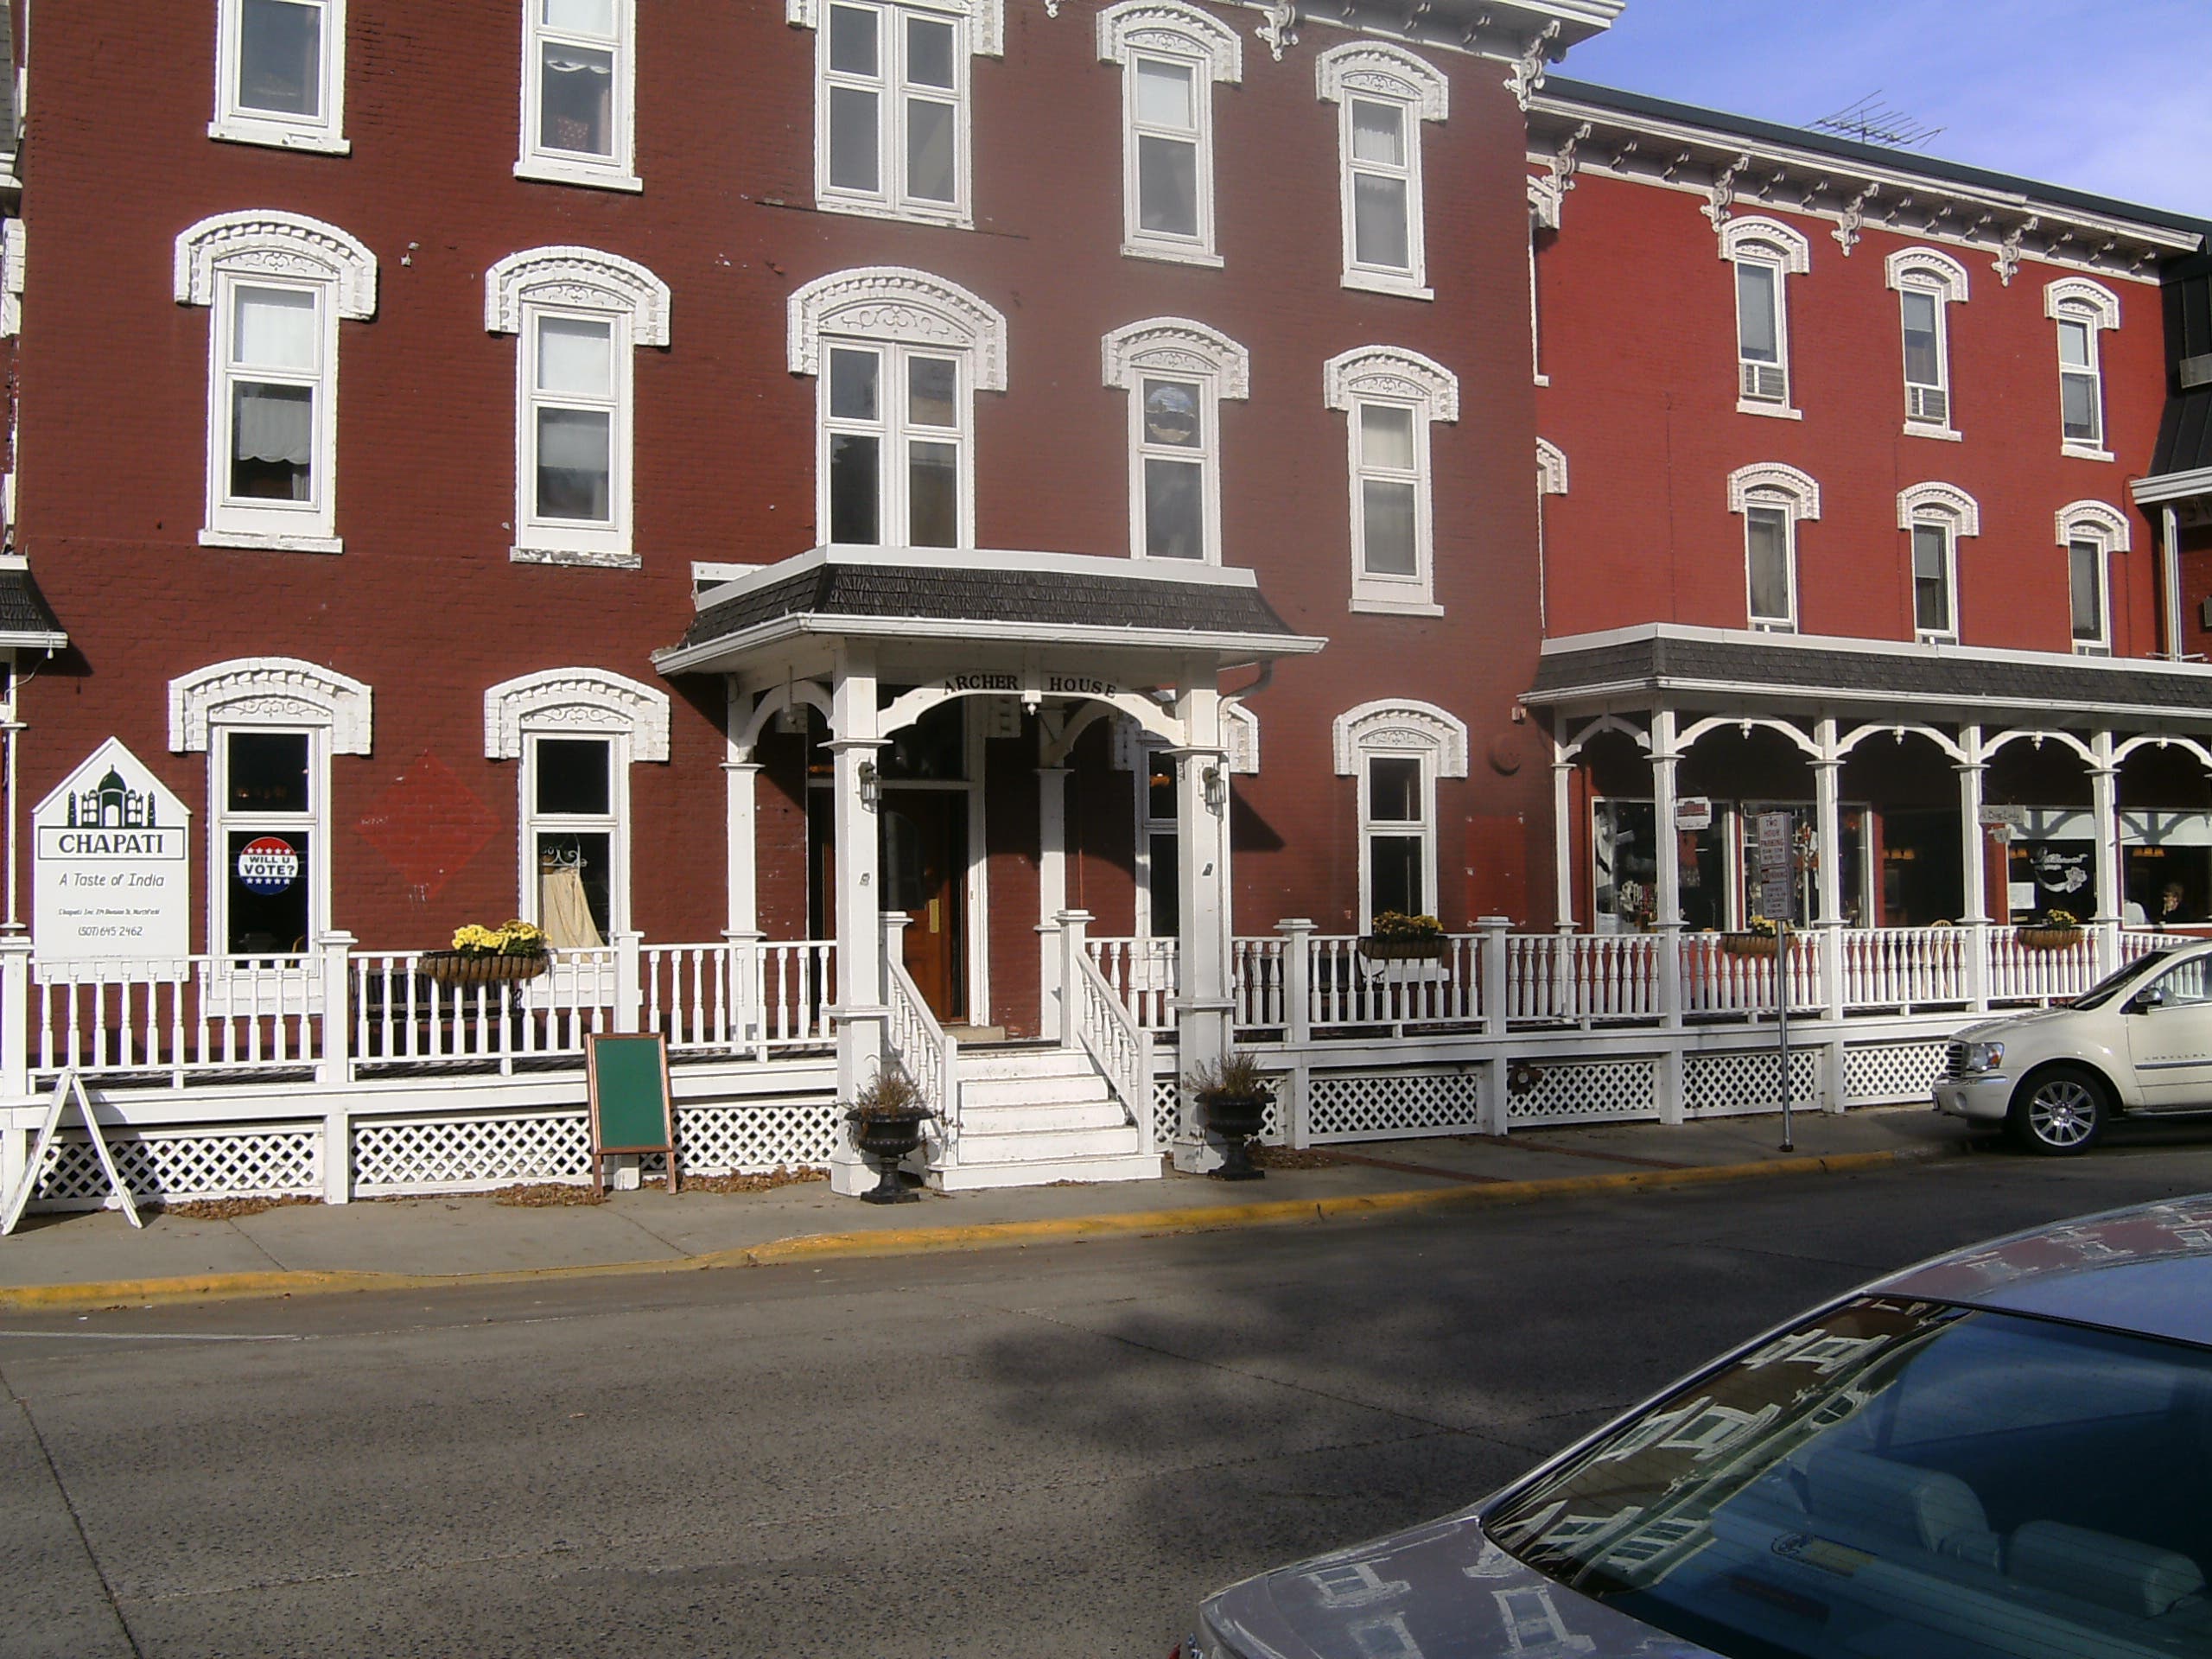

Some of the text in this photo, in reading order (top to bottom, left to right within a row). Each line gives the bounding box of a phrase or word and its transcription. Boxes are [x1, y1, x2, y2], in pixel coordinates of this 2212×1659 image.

[944, 674, 1116, 699] ARCHER HOUSE
[59, 834, 163, 854] CHAPATI
[245, 864, 295, 875] VOTE?
[59, 873, 164, 887] A Taste of India
[78, 926, 143, 937] (507) 645 2462
